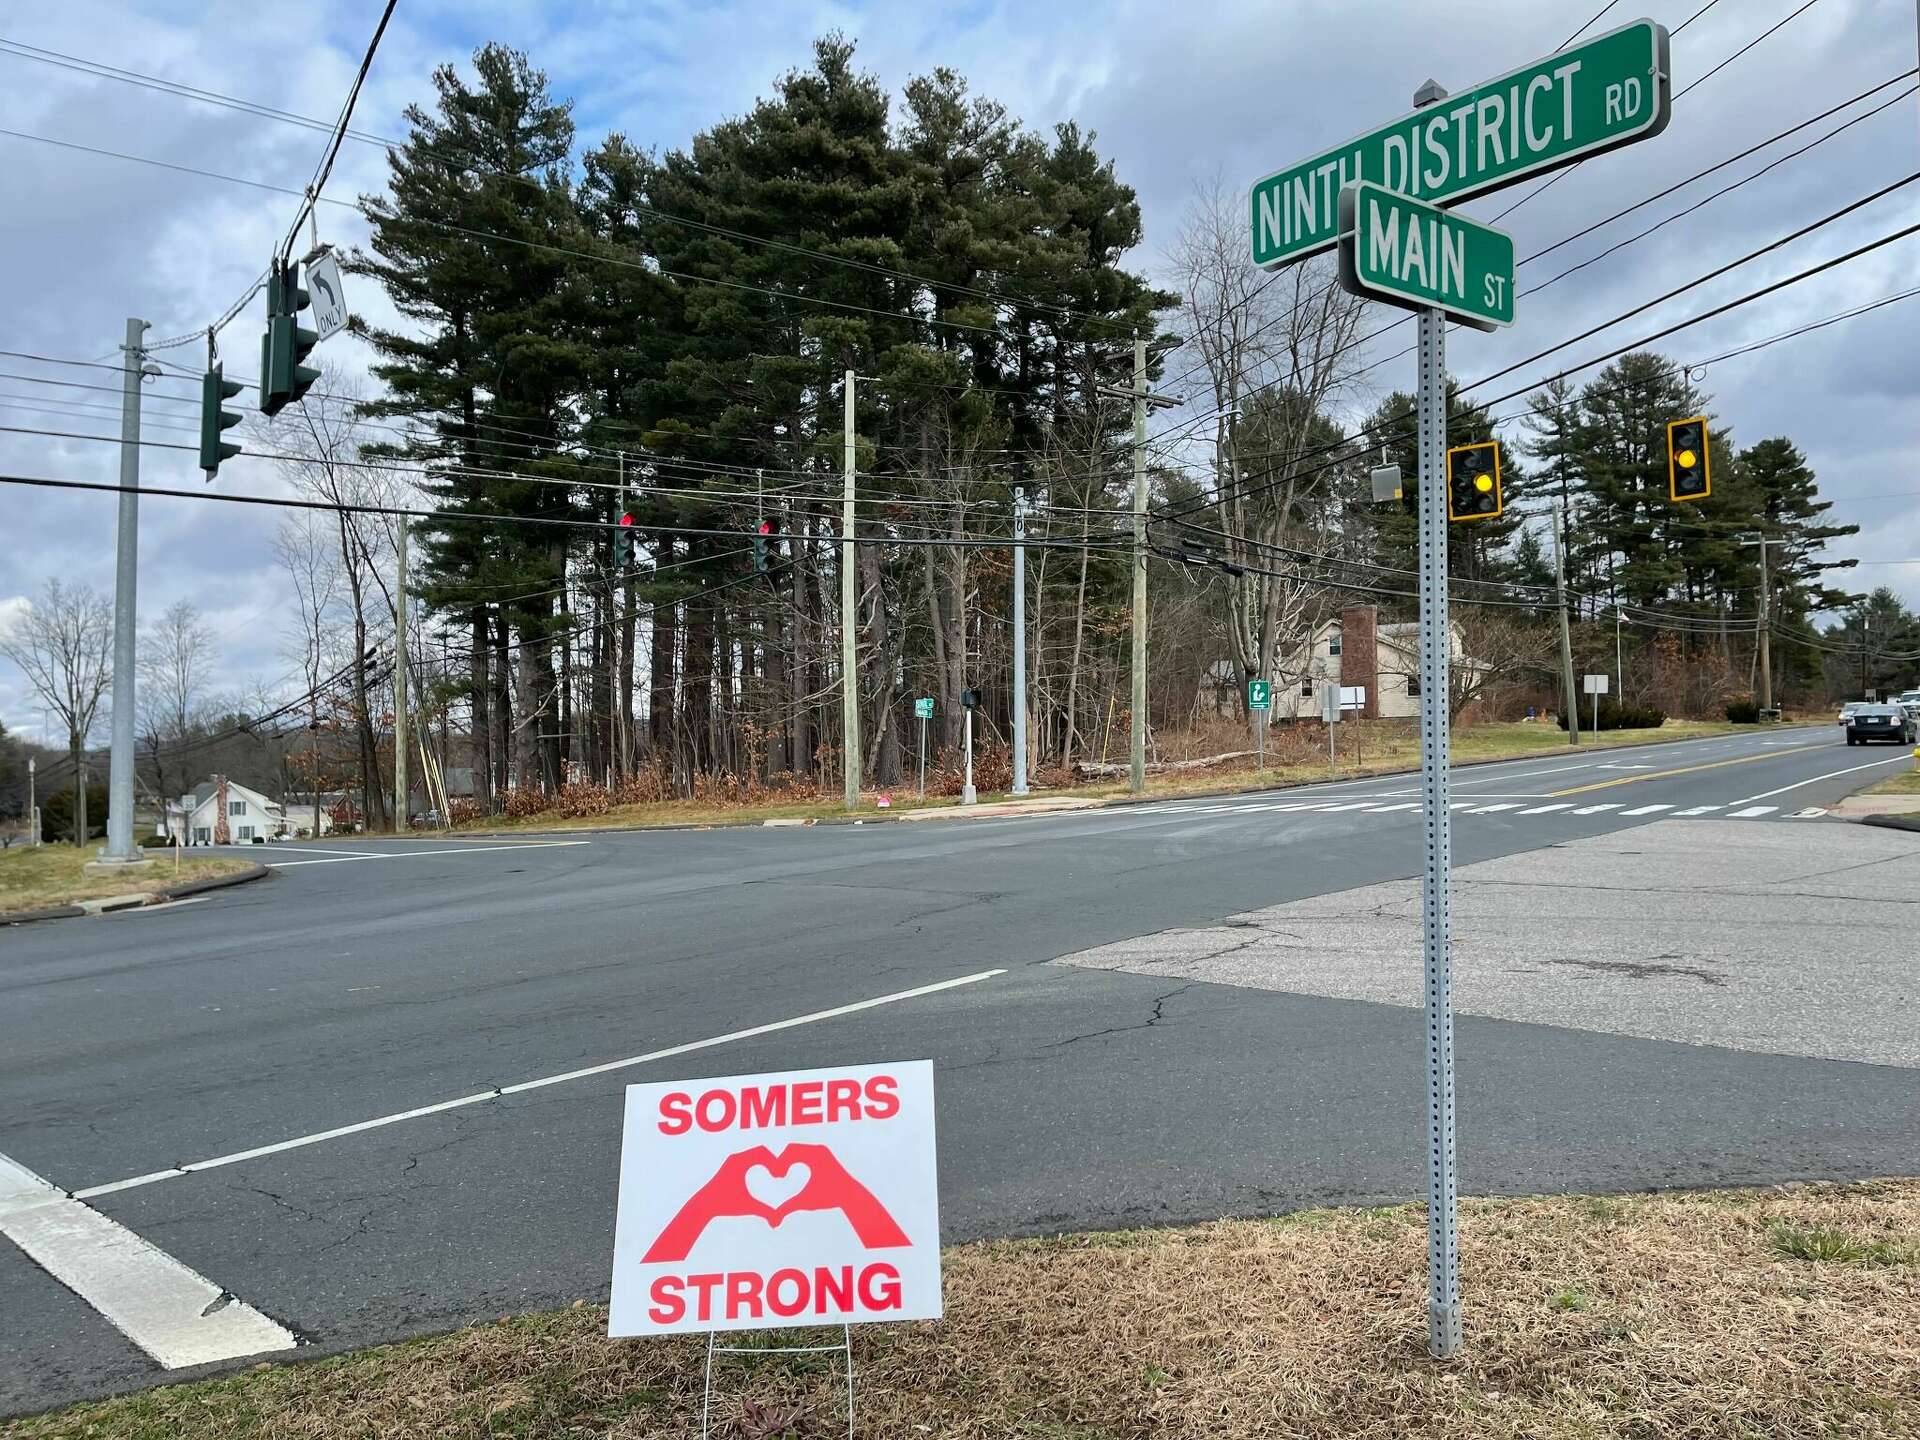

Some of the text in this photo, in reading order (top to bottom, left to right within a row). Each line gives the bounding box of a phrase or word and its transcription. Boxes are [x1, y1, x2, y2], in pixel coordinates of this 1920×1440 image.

[1383, 60, 1581, 199] DISTRICT
[1605, 77, 1641, 125] RD
[1369, 199, 1506, 311] MAIN ST
[320, 305, 342, 333] ONLY
[657, 1075, 901, 1136] SOMERS
[648, 1262, 902, 1324] STRONG
